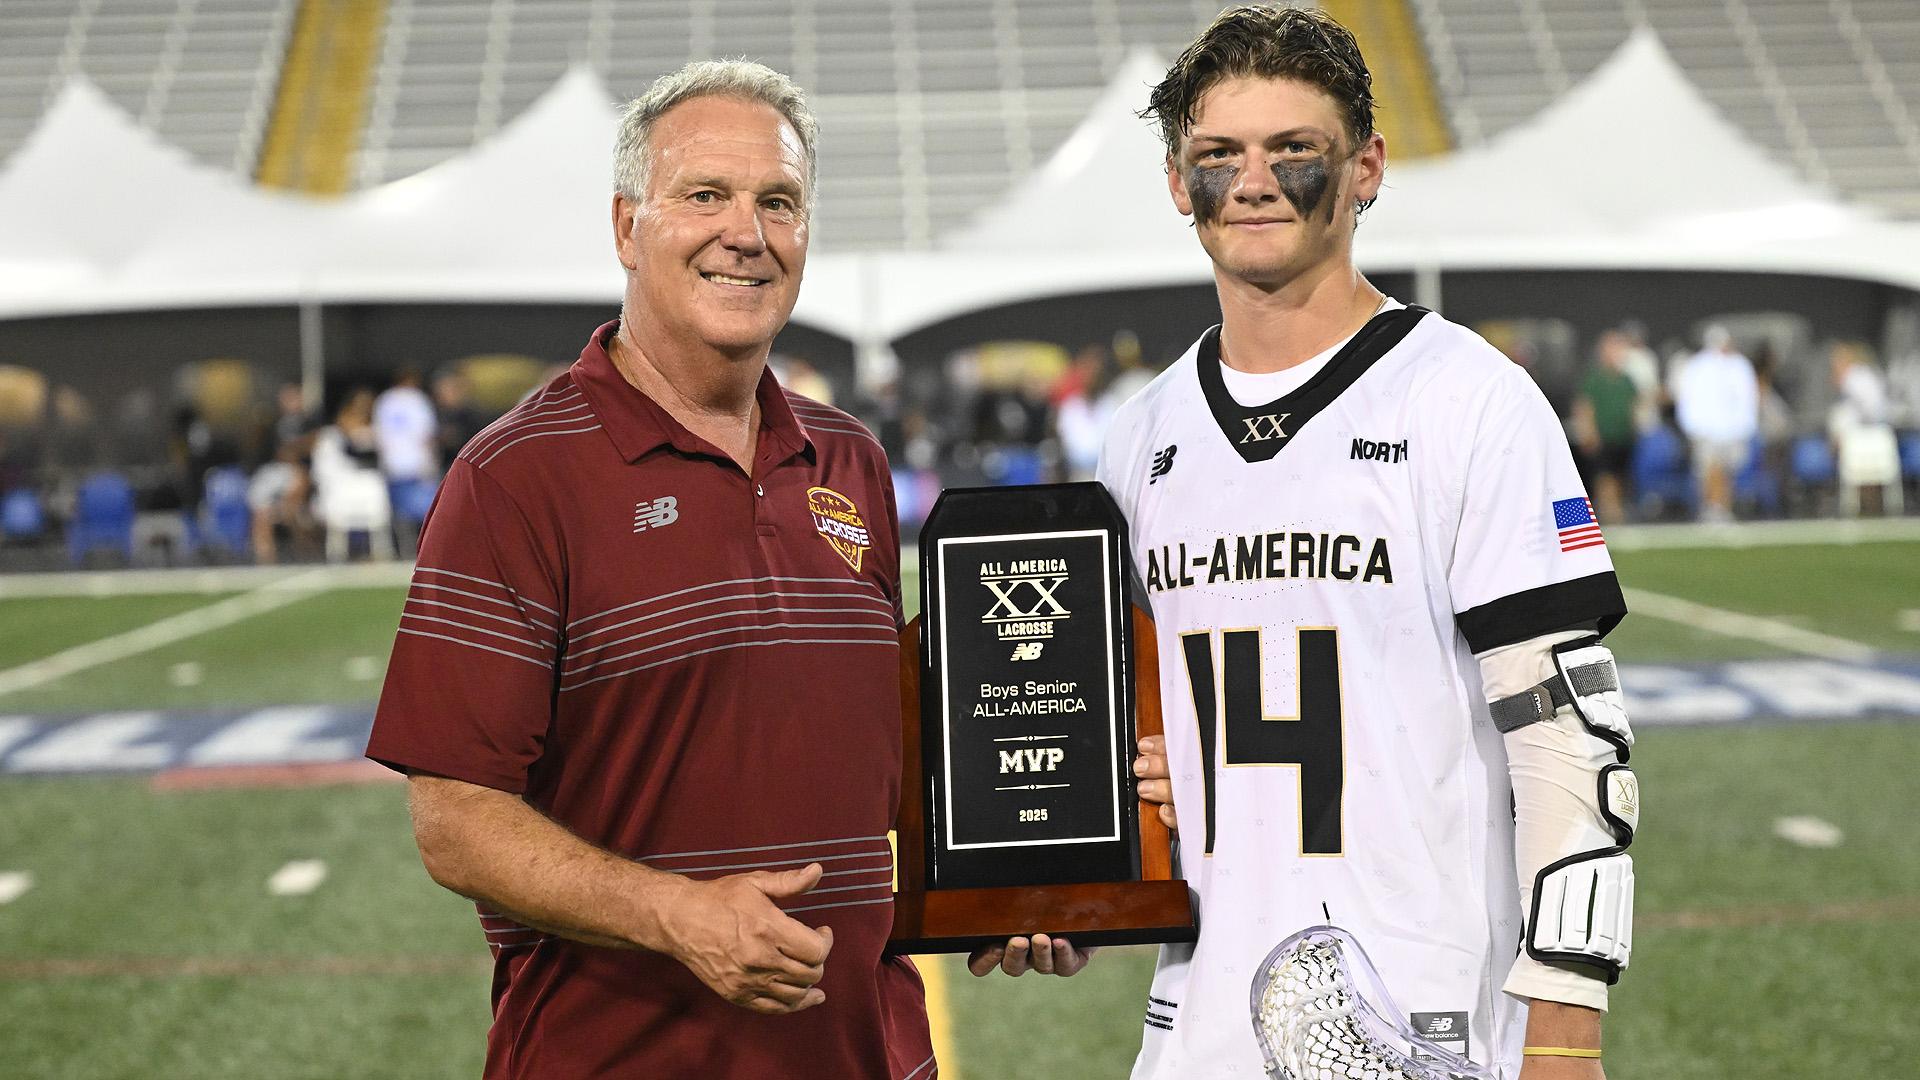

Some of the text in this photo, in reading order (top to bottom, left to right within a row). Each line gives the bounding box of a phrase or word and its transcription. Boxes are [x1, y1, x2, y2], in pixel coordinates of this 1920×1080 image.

[1240, 413, 1291, 444] XX
[1350, 438, 1407, 463] NORTH
[808, 501, 864, 527] ALL AMERICA
[812, 512, 870, 545] LACROSSE
[980, 559, 1067, 575] ALL AMERICA
[1147, 532, 1393, 594] ALL-AMERICA
[980, 577, 1071, 618] XX
[997, 621, 1053, 637] LACROSSE
[980, 680, 1077, 699] Boys Senior
[973, 698, 1087, 717] ALL-AMERICA
[1178, 626, 1346, 857] 14
[999, 747, 1064, 774] MVP
[1019, 809, 1048, 822] 2025
